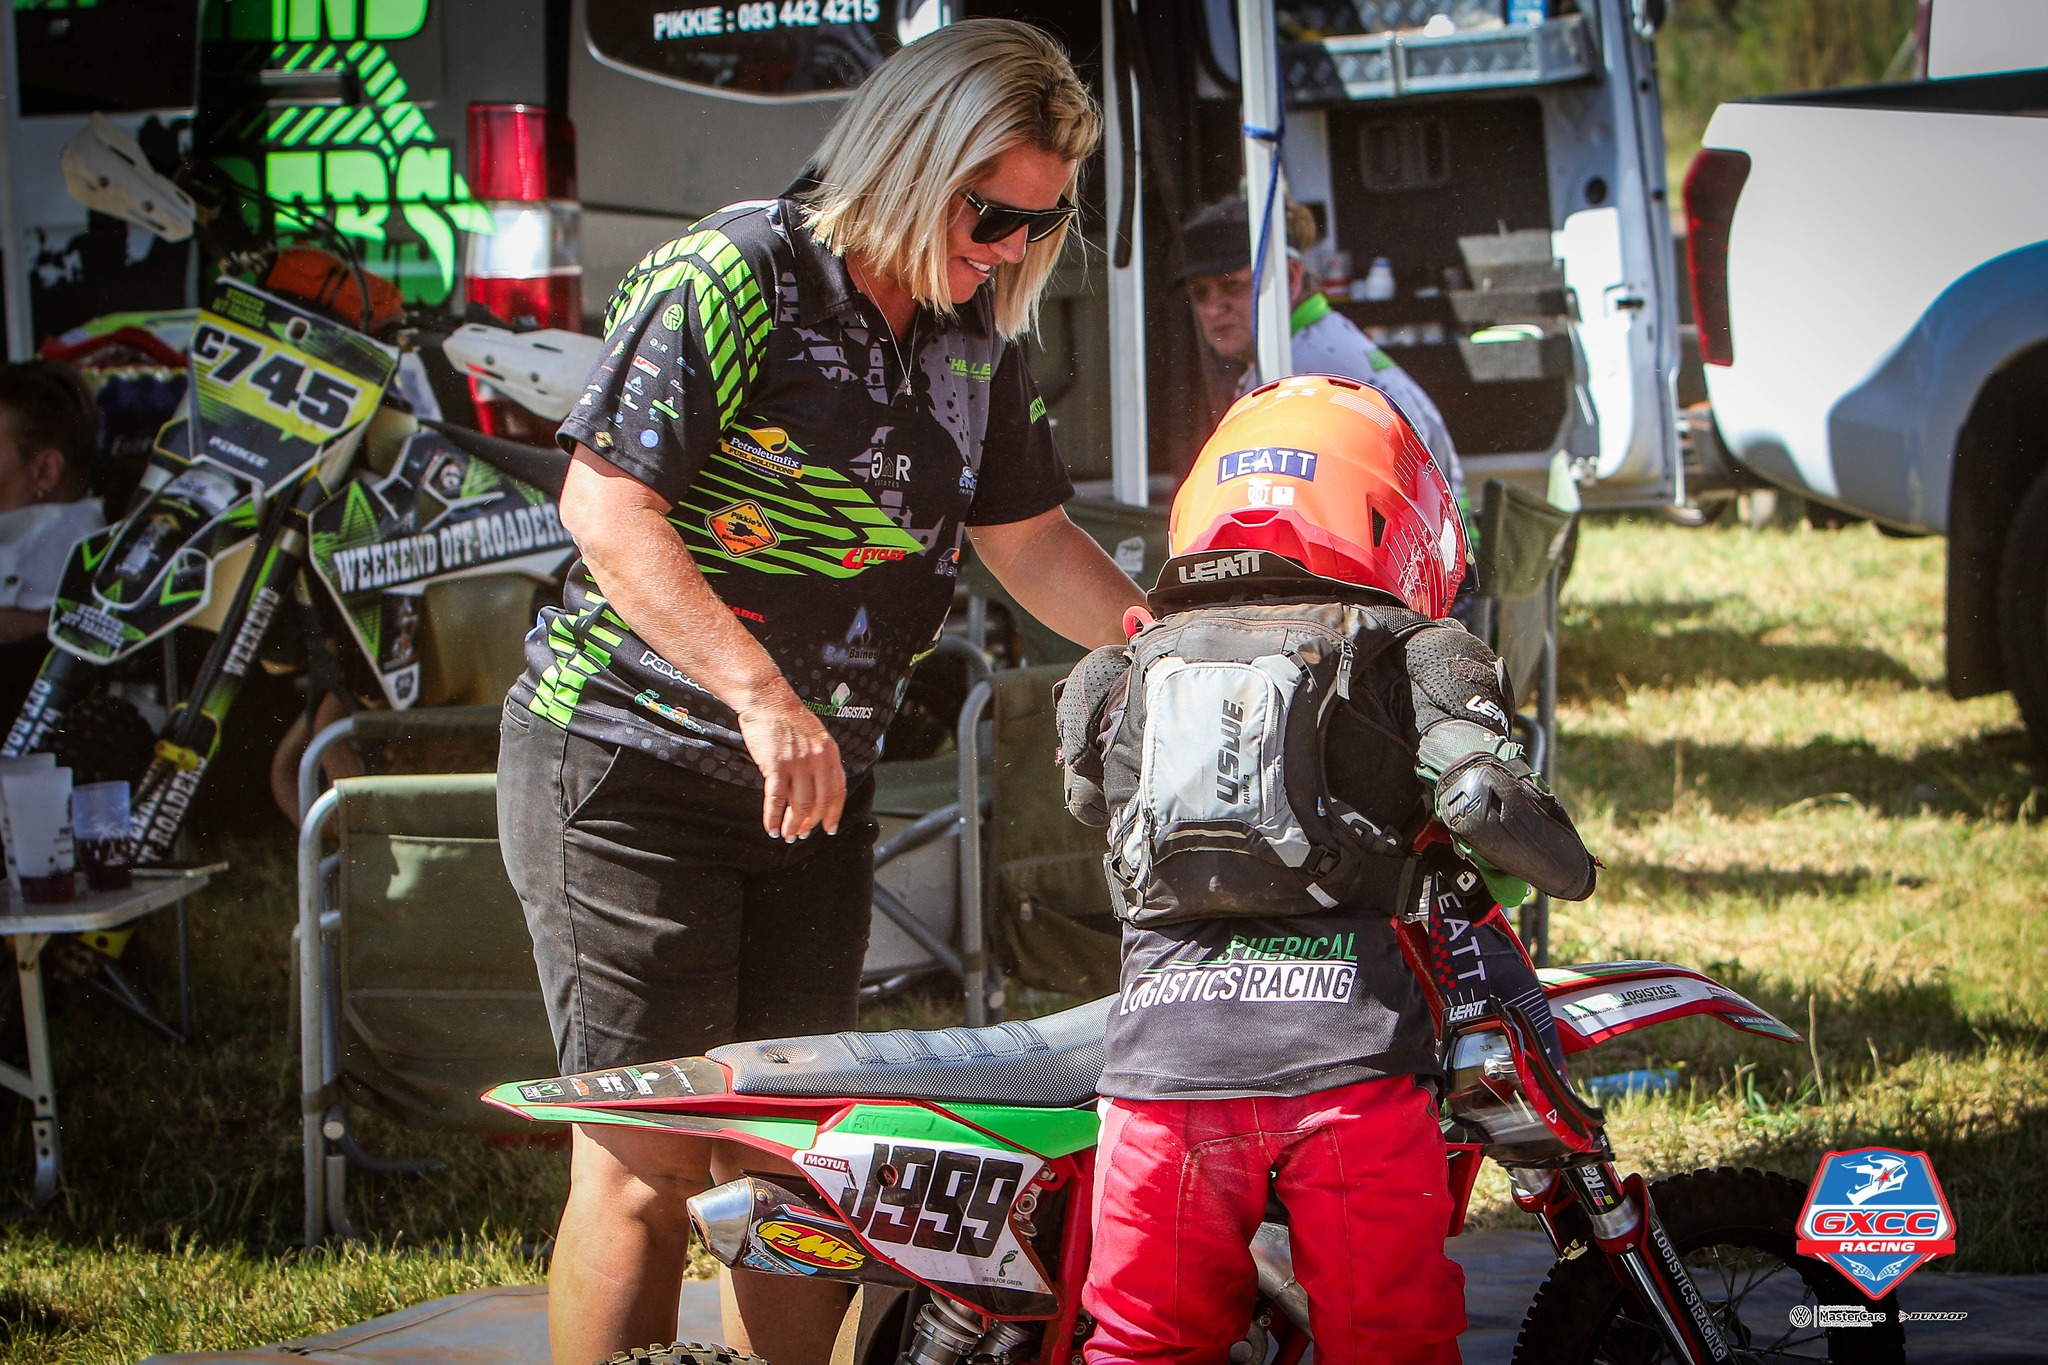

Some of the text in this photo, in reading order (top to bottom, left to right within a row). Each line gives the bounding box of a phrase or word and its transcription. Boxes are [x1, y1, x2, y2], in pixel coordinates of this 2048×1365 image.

[653, 6, 723, 41] PIKKIE
[737, 1, 777, 31] 083
[779, 0, 820, 27] 442
[822, 0, 881, 23] 4215
[191, 324, 362, 433] C745
[727, 447, 751, 462] FUEL
[749, 454, 796, 477] SOLUTIONS
[730, 437, 800, 469] Petroleumfix
[1221, 450, 1316, 481] LEATT
[333, 502, 576, 593] WEEKEND OFF-ROADER
[1178, 551, 1263, 584] LEATT
[727, 604, 765, 624] ABEL
[848, 647, 879, 660] Baines
[836, 705, 874, 719] LOGISTICS
[1216, 699, 1244, 805] USWE
[1242, 784, 1251, 805] RAW
[1245, 966, 1355, 1000] RACING
[1620, 984, 1677, 1002] LOGISTICS
[1449, 1000, 1488, 1021] LEATT
[804, 1154, 848, 1172] MOTUL
[757, 1222, 866, 1265] FMF
[1006, 1279, 1024, 1287] GREEN
